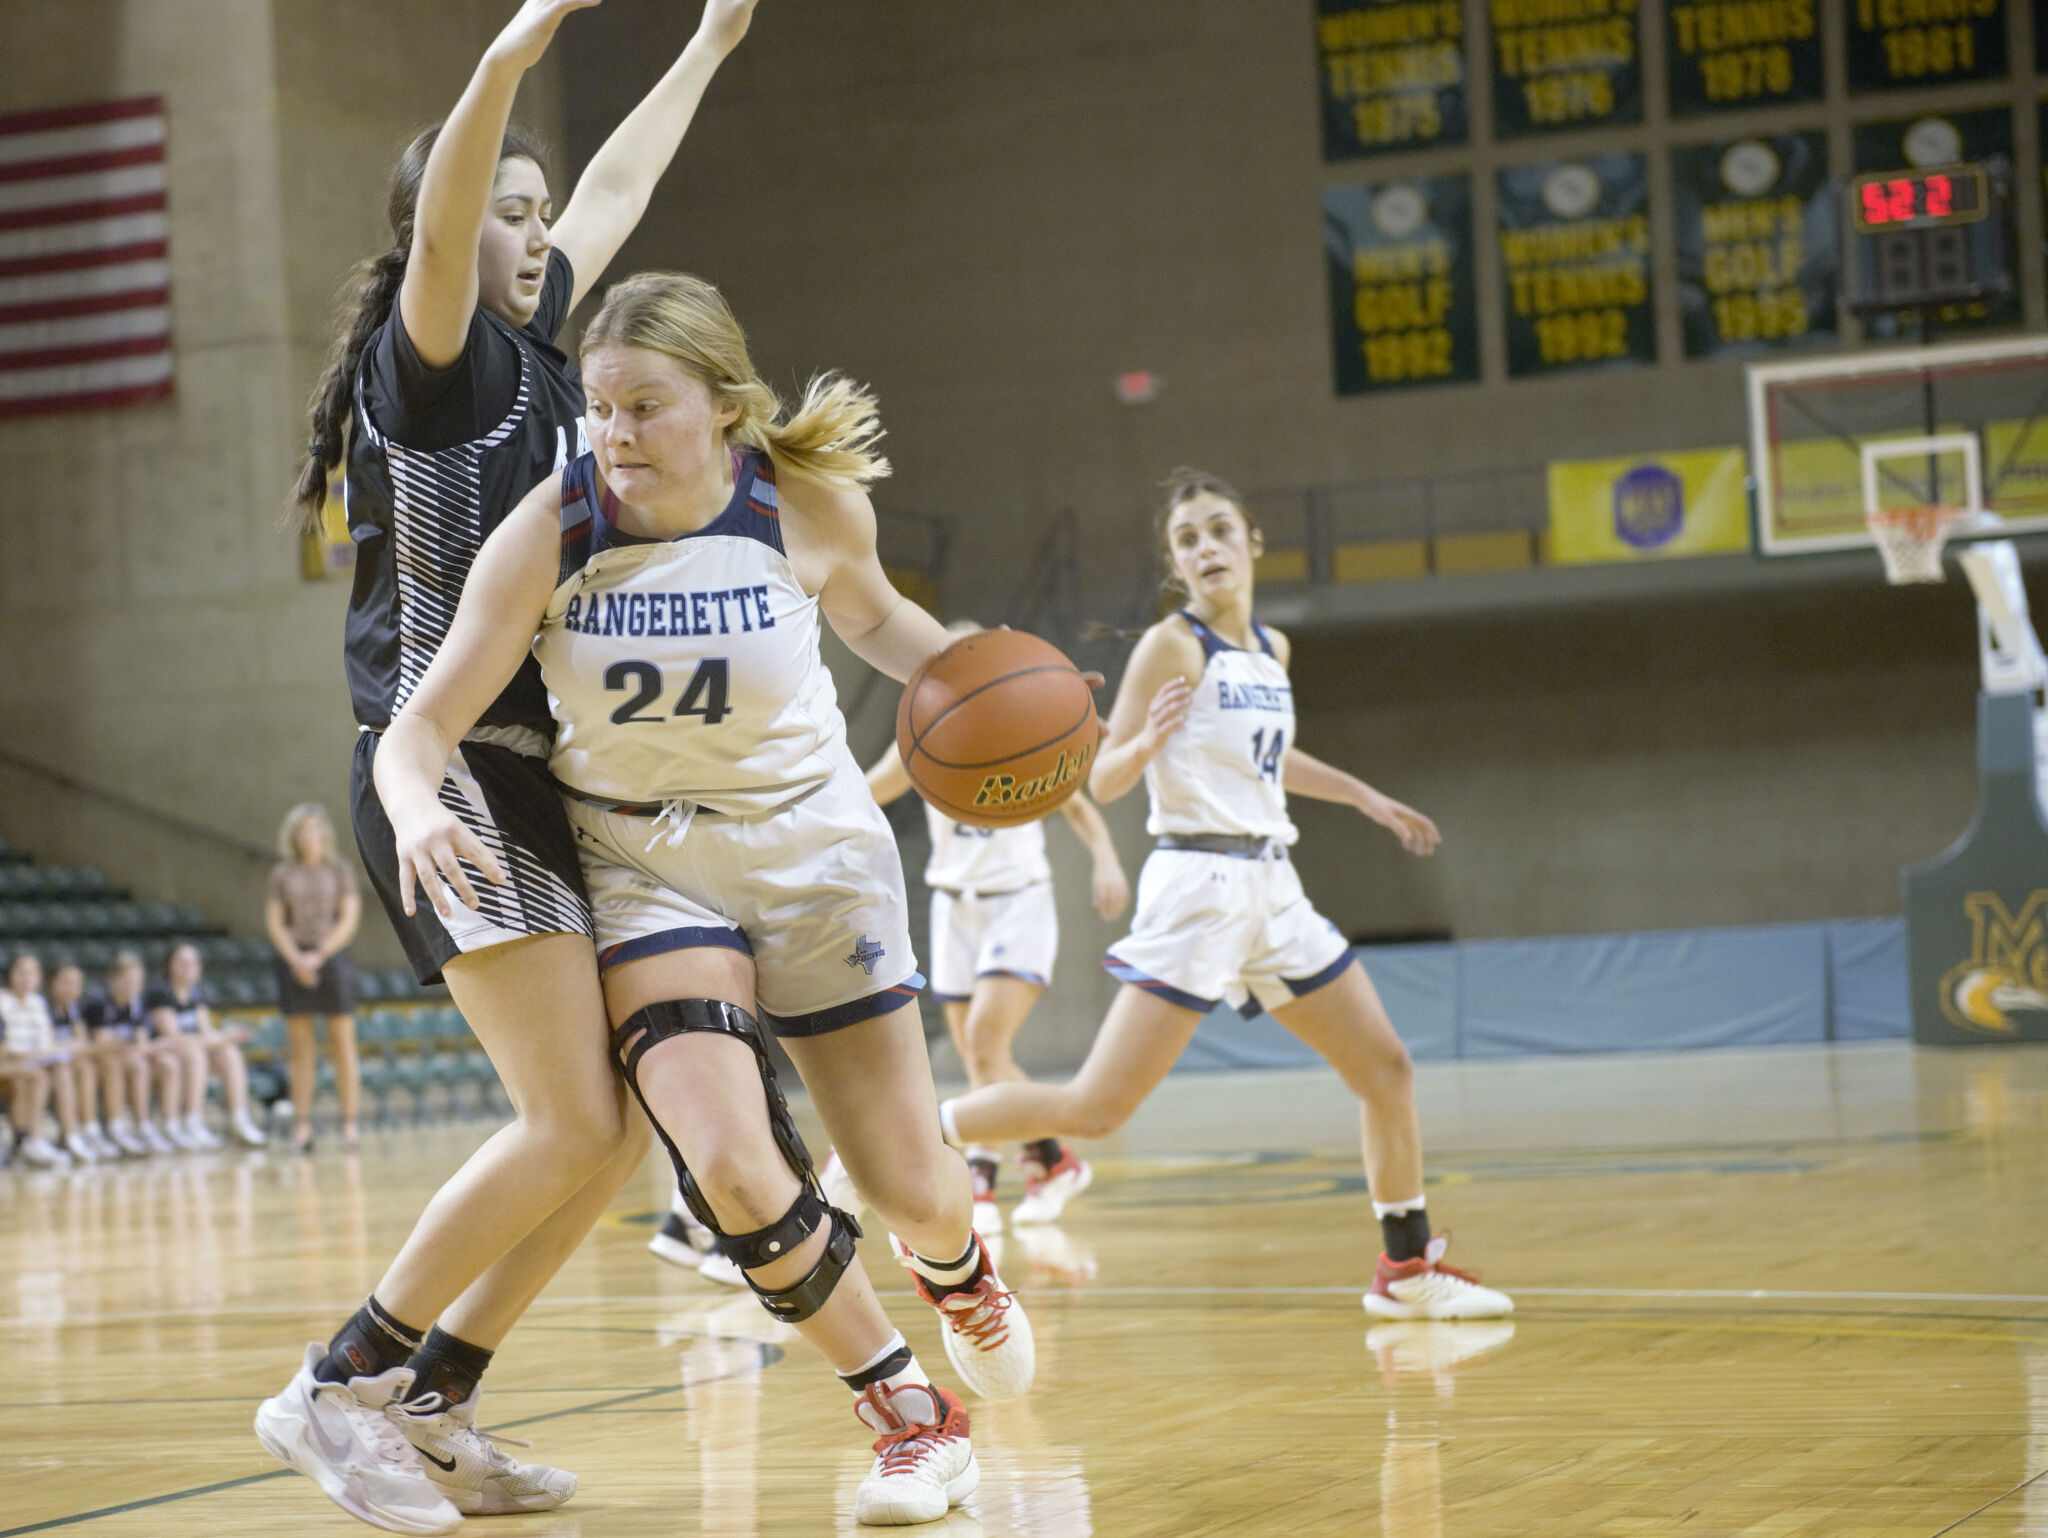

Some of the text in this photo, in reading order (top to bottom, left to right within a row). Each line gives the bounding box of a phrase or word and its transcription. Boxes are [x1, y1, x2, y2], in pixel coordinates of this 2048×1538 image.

[1499, 18, 1632, 76] TENNIS
[1672, 1, 1814, 54] TENNIS
[1510, 260, 1645, 317] TENNIS
[1705, 238, 1801, 295] GOLF
[1356, 279, 1449, 331] GOLF
[564, 583, 776, 637] RANGERETTE
[602, 656, 734, 725] 24
[973, 743, 1090, 806] Baden
[1251, 727, 1284, 785] 14
